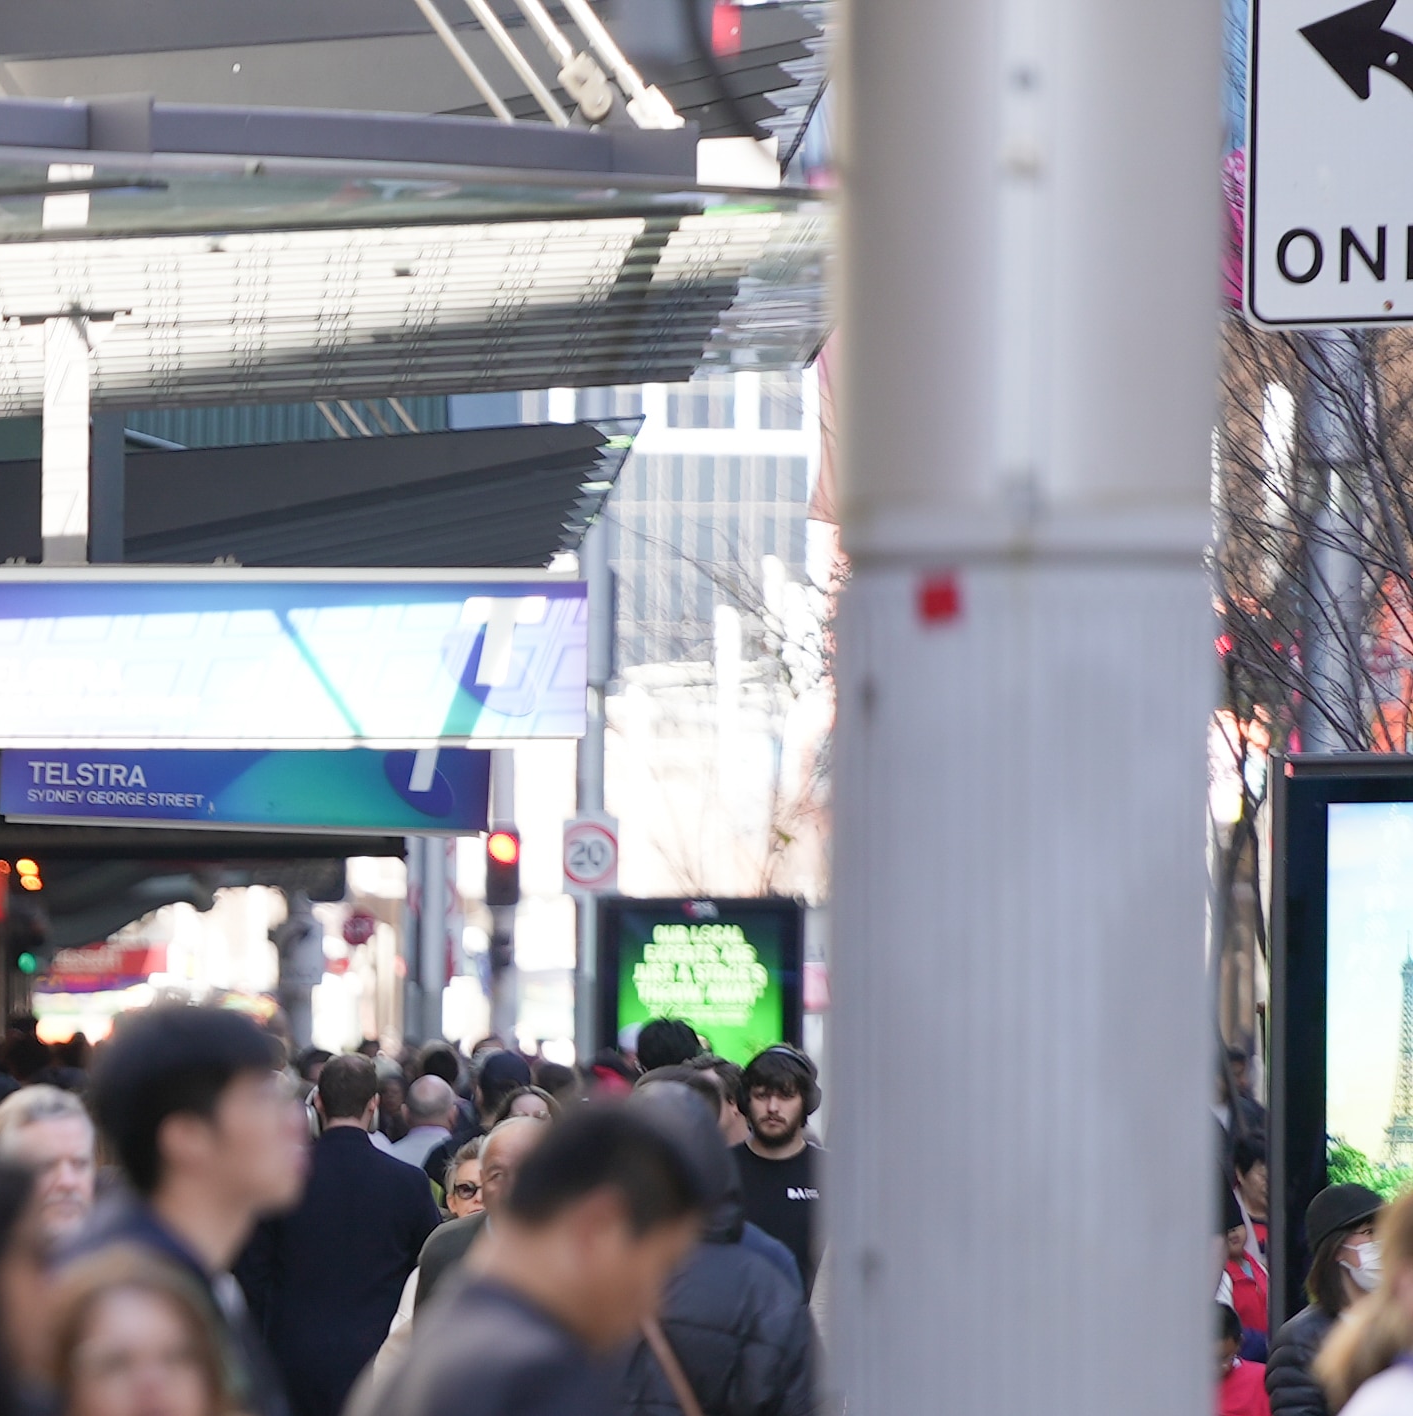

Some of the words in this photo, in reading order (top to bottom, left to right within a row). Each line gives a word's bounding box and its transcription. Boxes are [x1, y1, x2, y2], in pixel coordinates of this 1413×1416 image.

[1277, 224, 1413, 284] ON
[28, 761, 148, 788] TELSTRA
[27, 789, 85, 805] SYDNEY
[86, 790, 147, 807] GEORGE
[147, 793, 206, 809] STREET
[569, 838, 607, 868] 20
